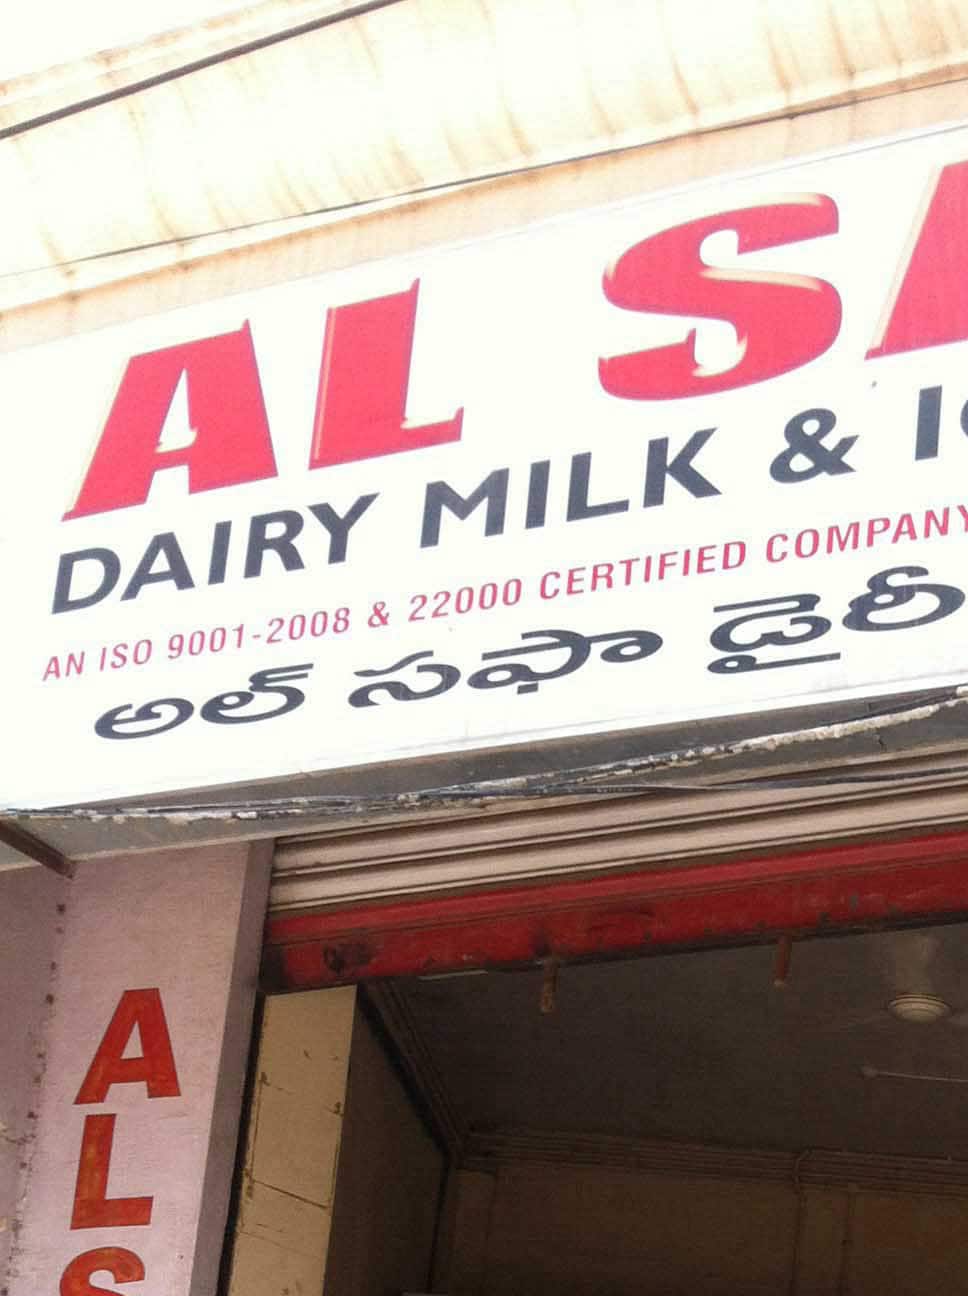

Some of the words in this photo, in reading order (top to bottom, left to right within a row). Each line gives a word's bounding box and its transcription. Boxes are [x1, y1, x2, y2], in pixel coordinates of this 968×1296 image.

[61, 277, 464, 521] AL
[51, 492, 380, 614] DAIRY
[419, 427, 722, 548] MILK
[769, 407, 860, 484] &
[42, 651, 85, 681] AN
[99, 639, 152, 671] ISO
[168, 607, 350, 659] 9001-2008
[367, 601, 390, 628] &
[408, 577, 523, 623] 22000
[539, 540, 747, 600] CERTIFIED
[94, 663, 314, 740] అల్
[348, 629, 663, 708] సఫా
